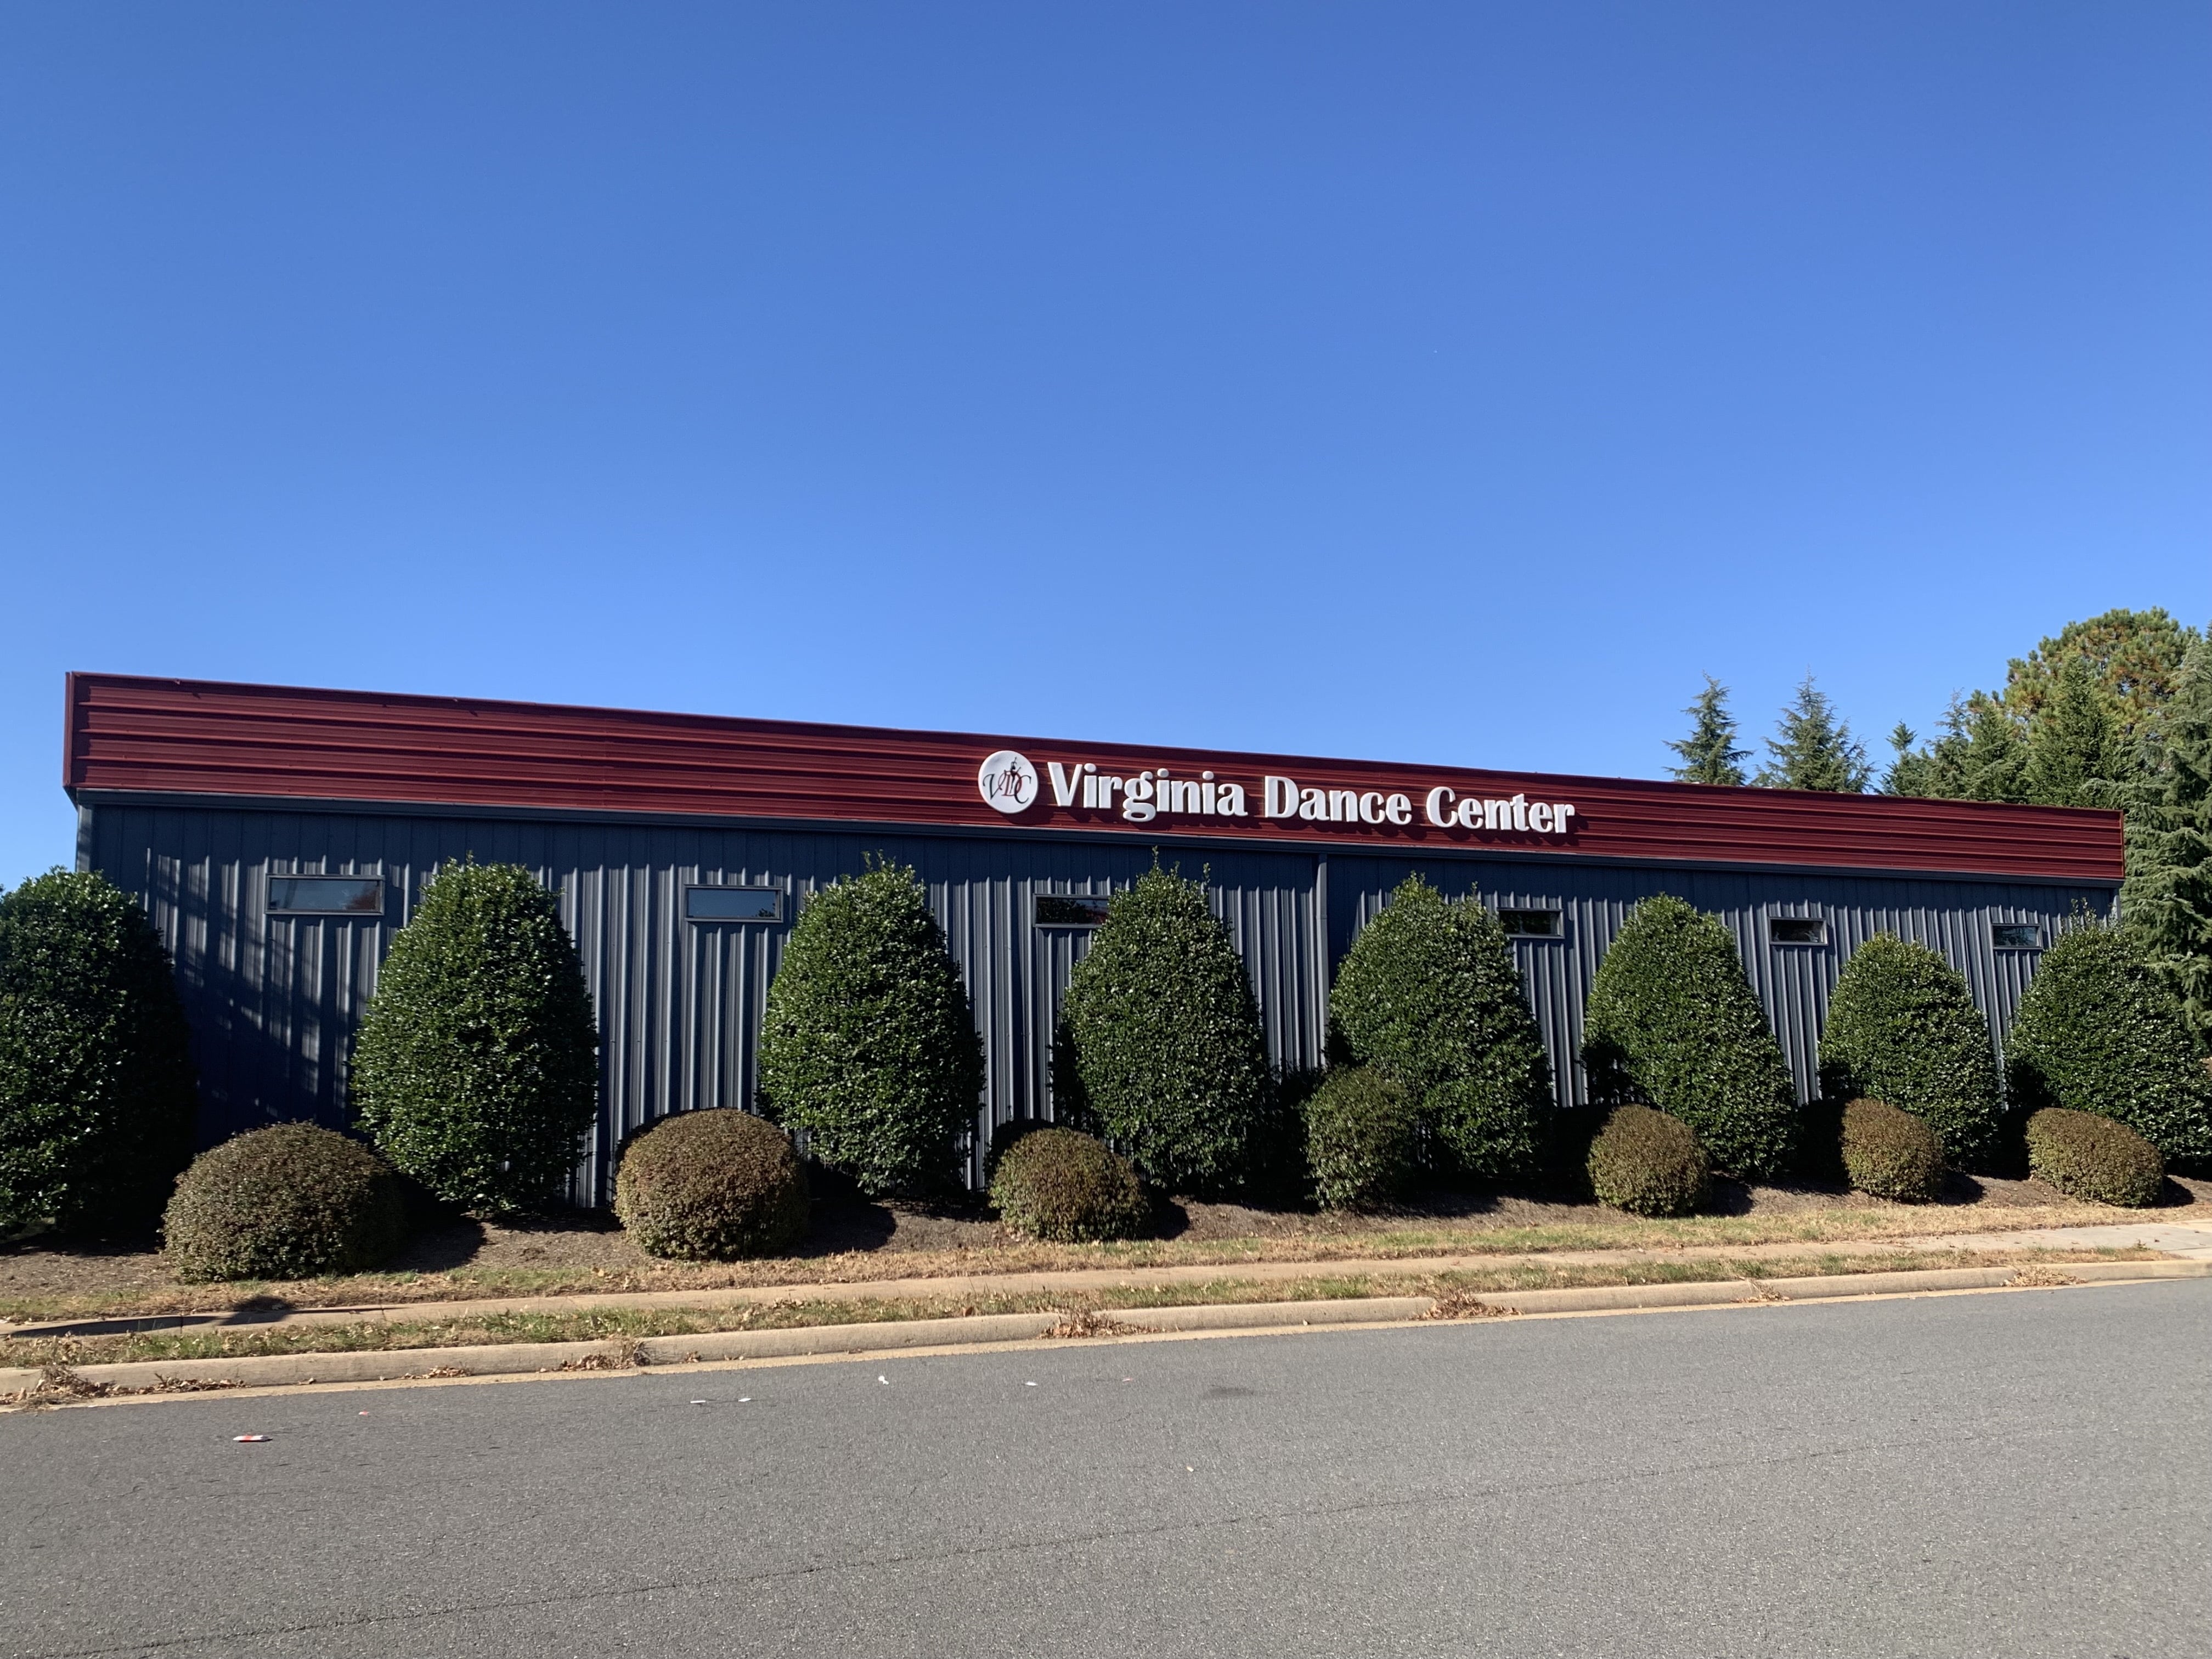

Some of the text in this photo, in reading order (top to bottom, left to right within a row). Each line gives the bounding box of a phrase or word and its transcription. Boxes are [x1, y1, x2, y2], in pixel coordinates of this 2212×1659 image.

[1047, 761, 1576, 833] Virginia Dance Center
